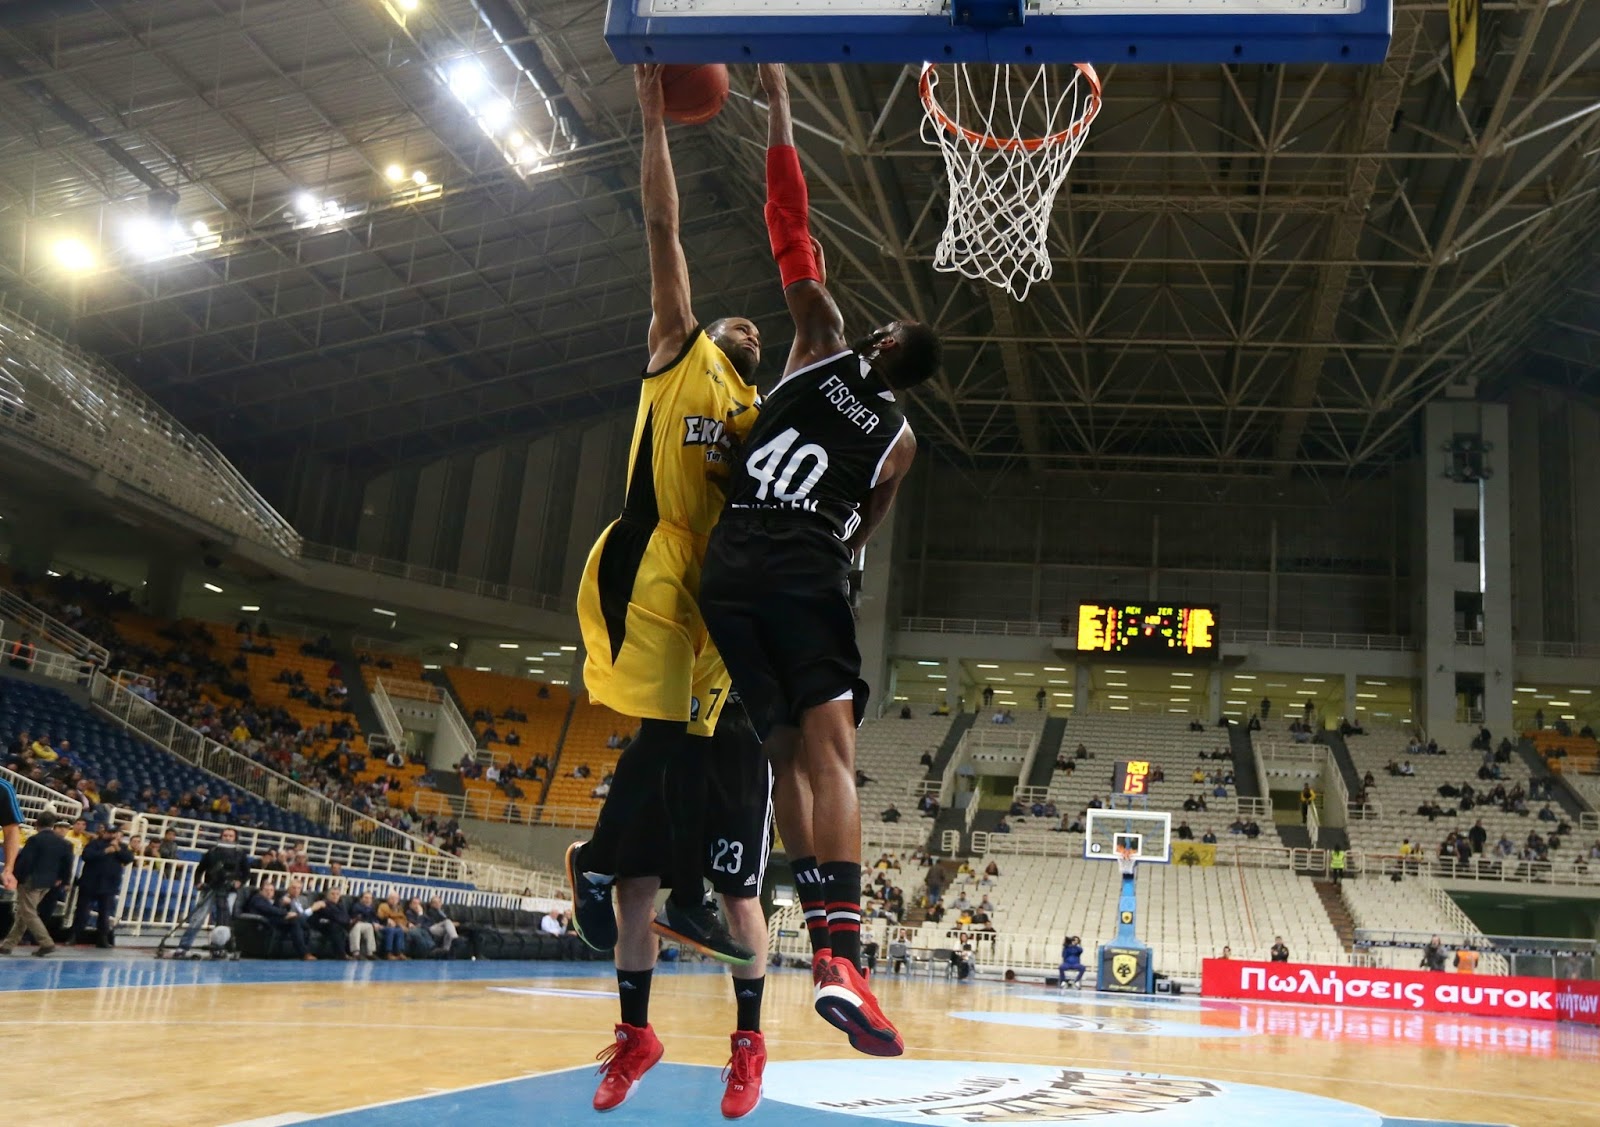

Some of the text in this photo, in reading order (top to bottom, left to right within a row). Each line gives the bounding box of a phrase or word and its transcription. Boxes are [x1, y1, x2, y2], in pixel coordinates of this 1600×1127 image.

[818, 374, 880, 434] FISCHER
[745, 426, 829, 501] 40
[704, 688, 723, 721] 7
[1124, 774, 1144, 793] 15
[712, 838, 744, 875] 23
[1240, 967, 1424, 1008] Πωλήσεις
